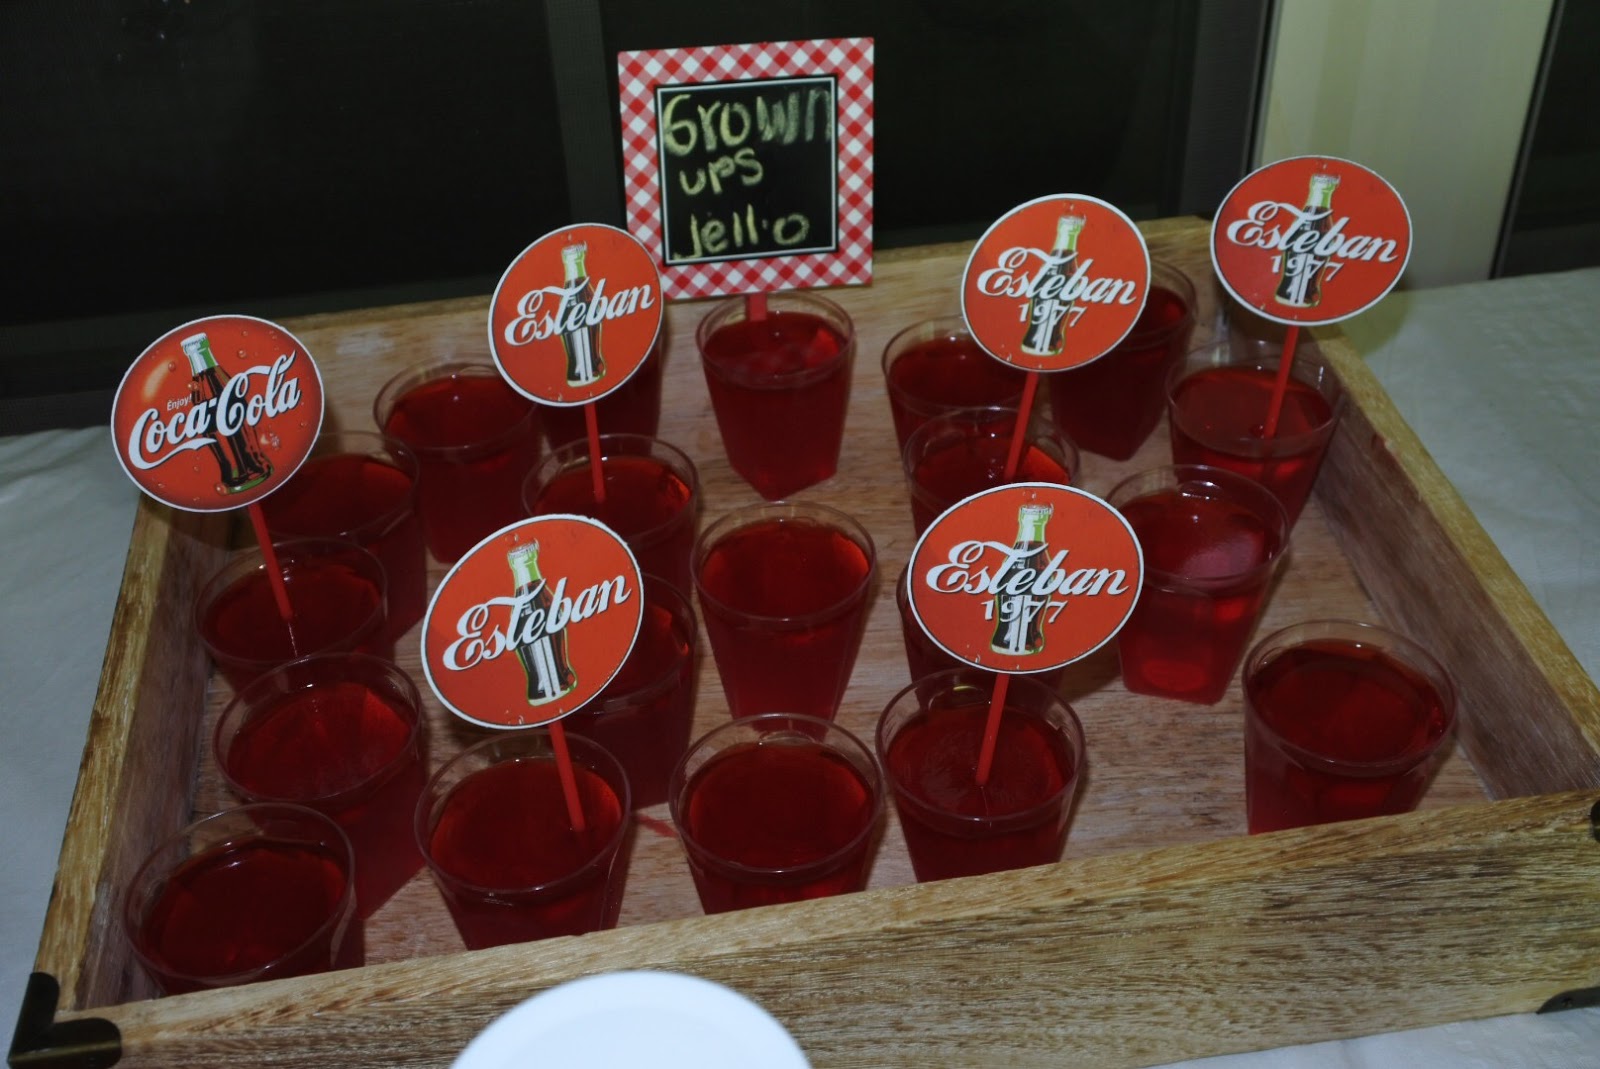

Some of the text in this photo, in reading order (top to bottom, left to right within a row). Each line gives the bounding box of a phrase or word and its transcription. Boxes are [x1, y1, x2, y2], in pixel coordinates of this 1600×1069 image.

[679, 148, 763, 195] ups
[1227, 200, 1398, 262] Esteban
[977, 246, 1137, 304] Esteban
[1270, 255, 1344, 282] 1977
[504, 276, 655, 346] Esteban
[1018, 303, 1087, 328] 1977
[128, 350, 302, 470] Coca-Cola
[926, 540, 1129, 596] Esteban
[443, 576, 631, 670] Esteban
[981, 599, 1068, 623] 1977
